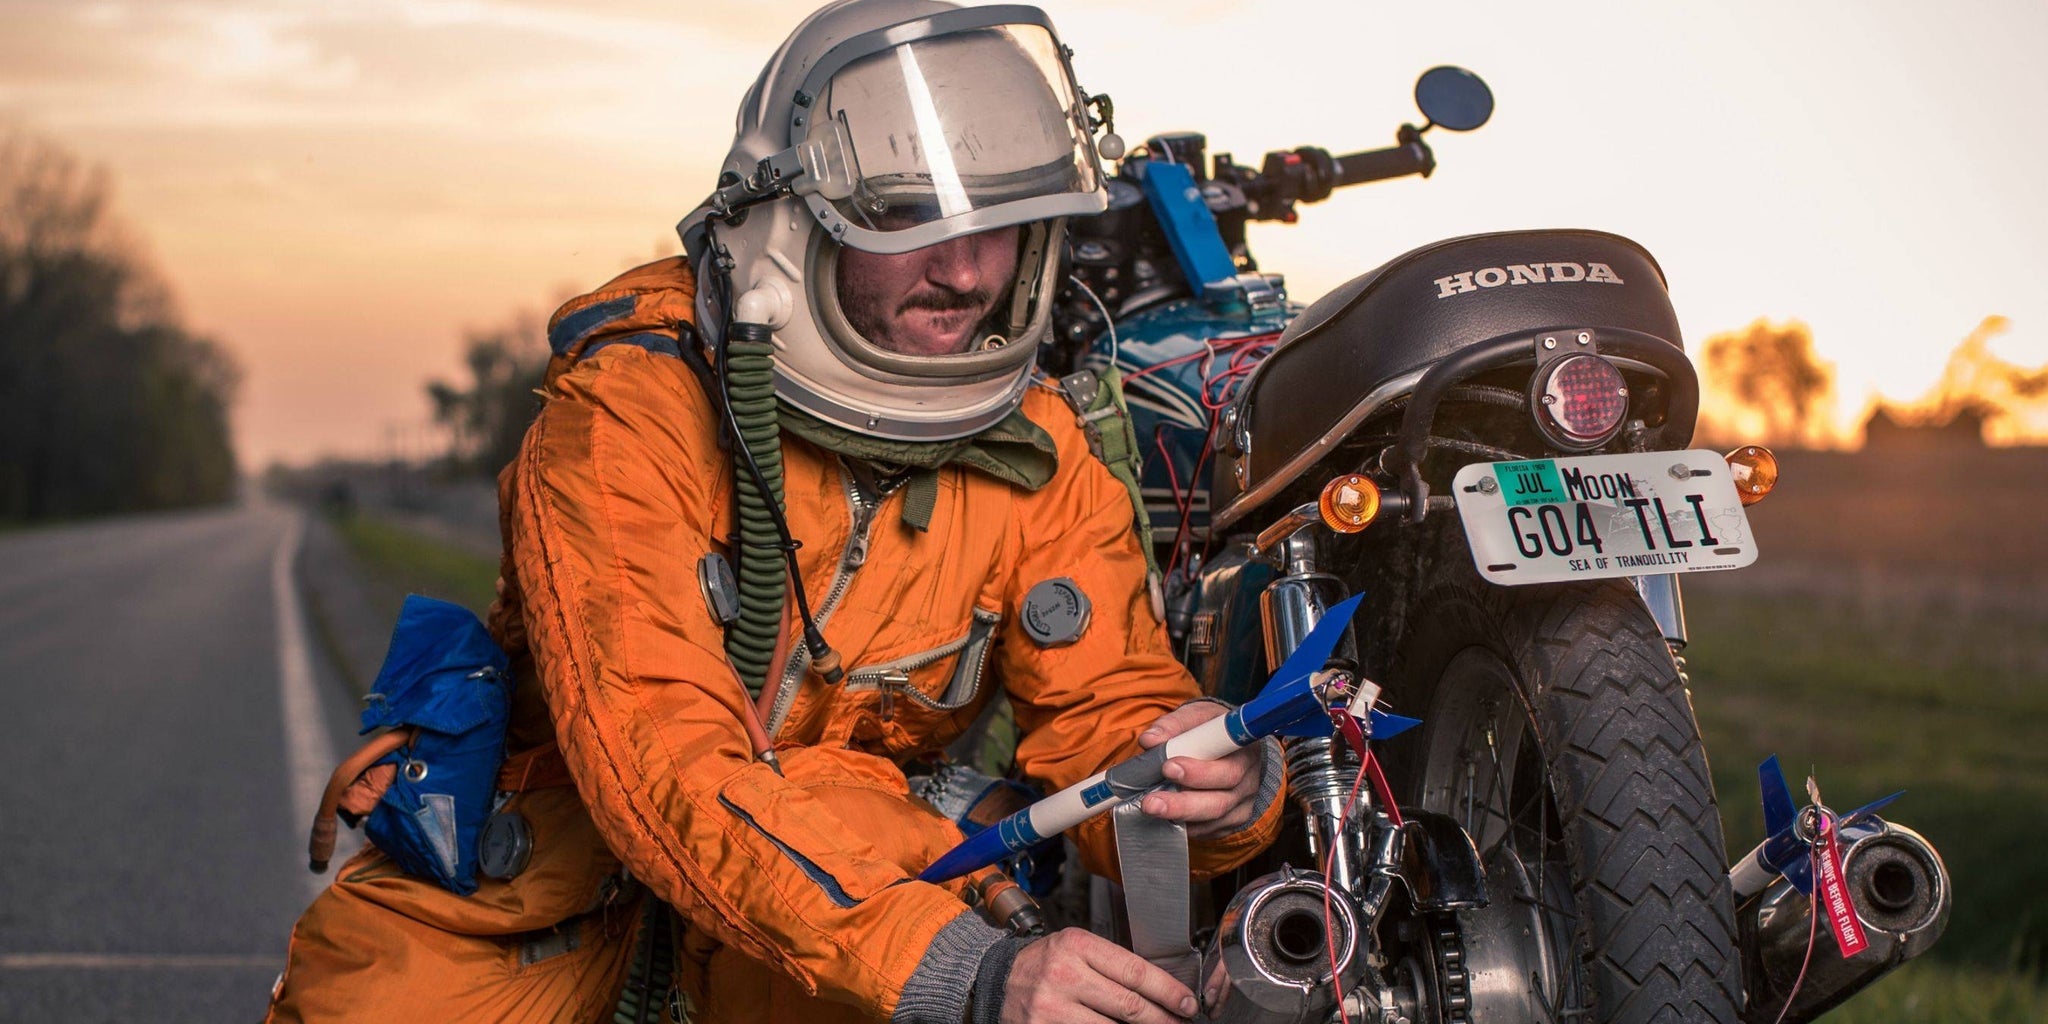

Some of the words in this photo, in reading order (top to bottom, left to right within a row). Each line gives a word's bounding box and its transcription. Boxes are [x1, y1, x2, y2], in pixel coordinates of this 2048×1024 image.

[1433, 262, 1625, 299] HONDA
[1515, 472, 1552, 494] JUL
[1624, 494, 1719, 550] TLI
[1569, 559, 1591, 571] SEA
[1595, 557, 1608, 570] OF
[1616, 551, 1689, 568] TRANQUILITY
[1821, 848, 1837, 885] REMOVE
[1828, 881, 1847, 917] BEFORE
[1838, 914, 1859, 947] FLIGHT
